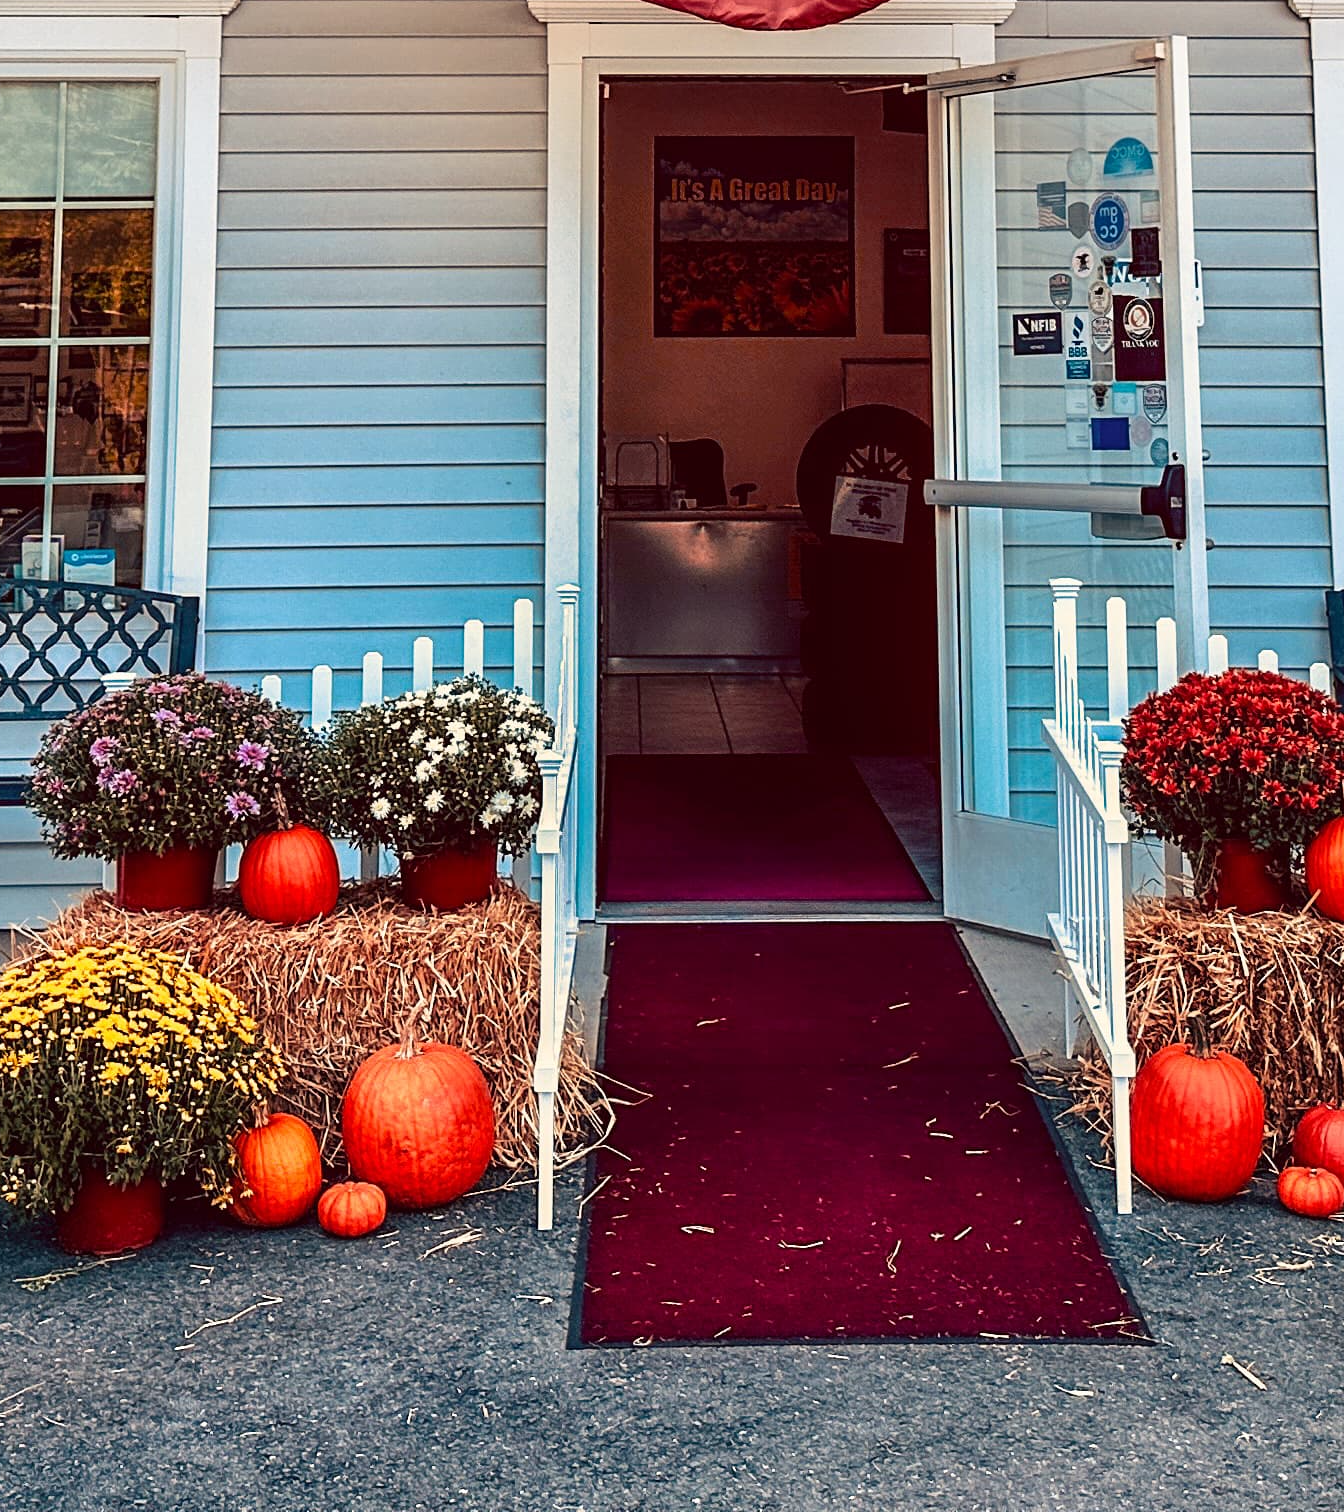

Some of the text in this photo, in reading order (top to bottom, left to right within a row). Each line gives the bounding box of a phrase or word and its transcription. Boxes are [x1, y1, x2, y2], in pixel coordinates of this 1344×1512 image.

[671, 178, 838, 204] It's A Great Day
[1030, 318, 1057, 332] NFIB
[1068, 346, 1088, 357] BBB
